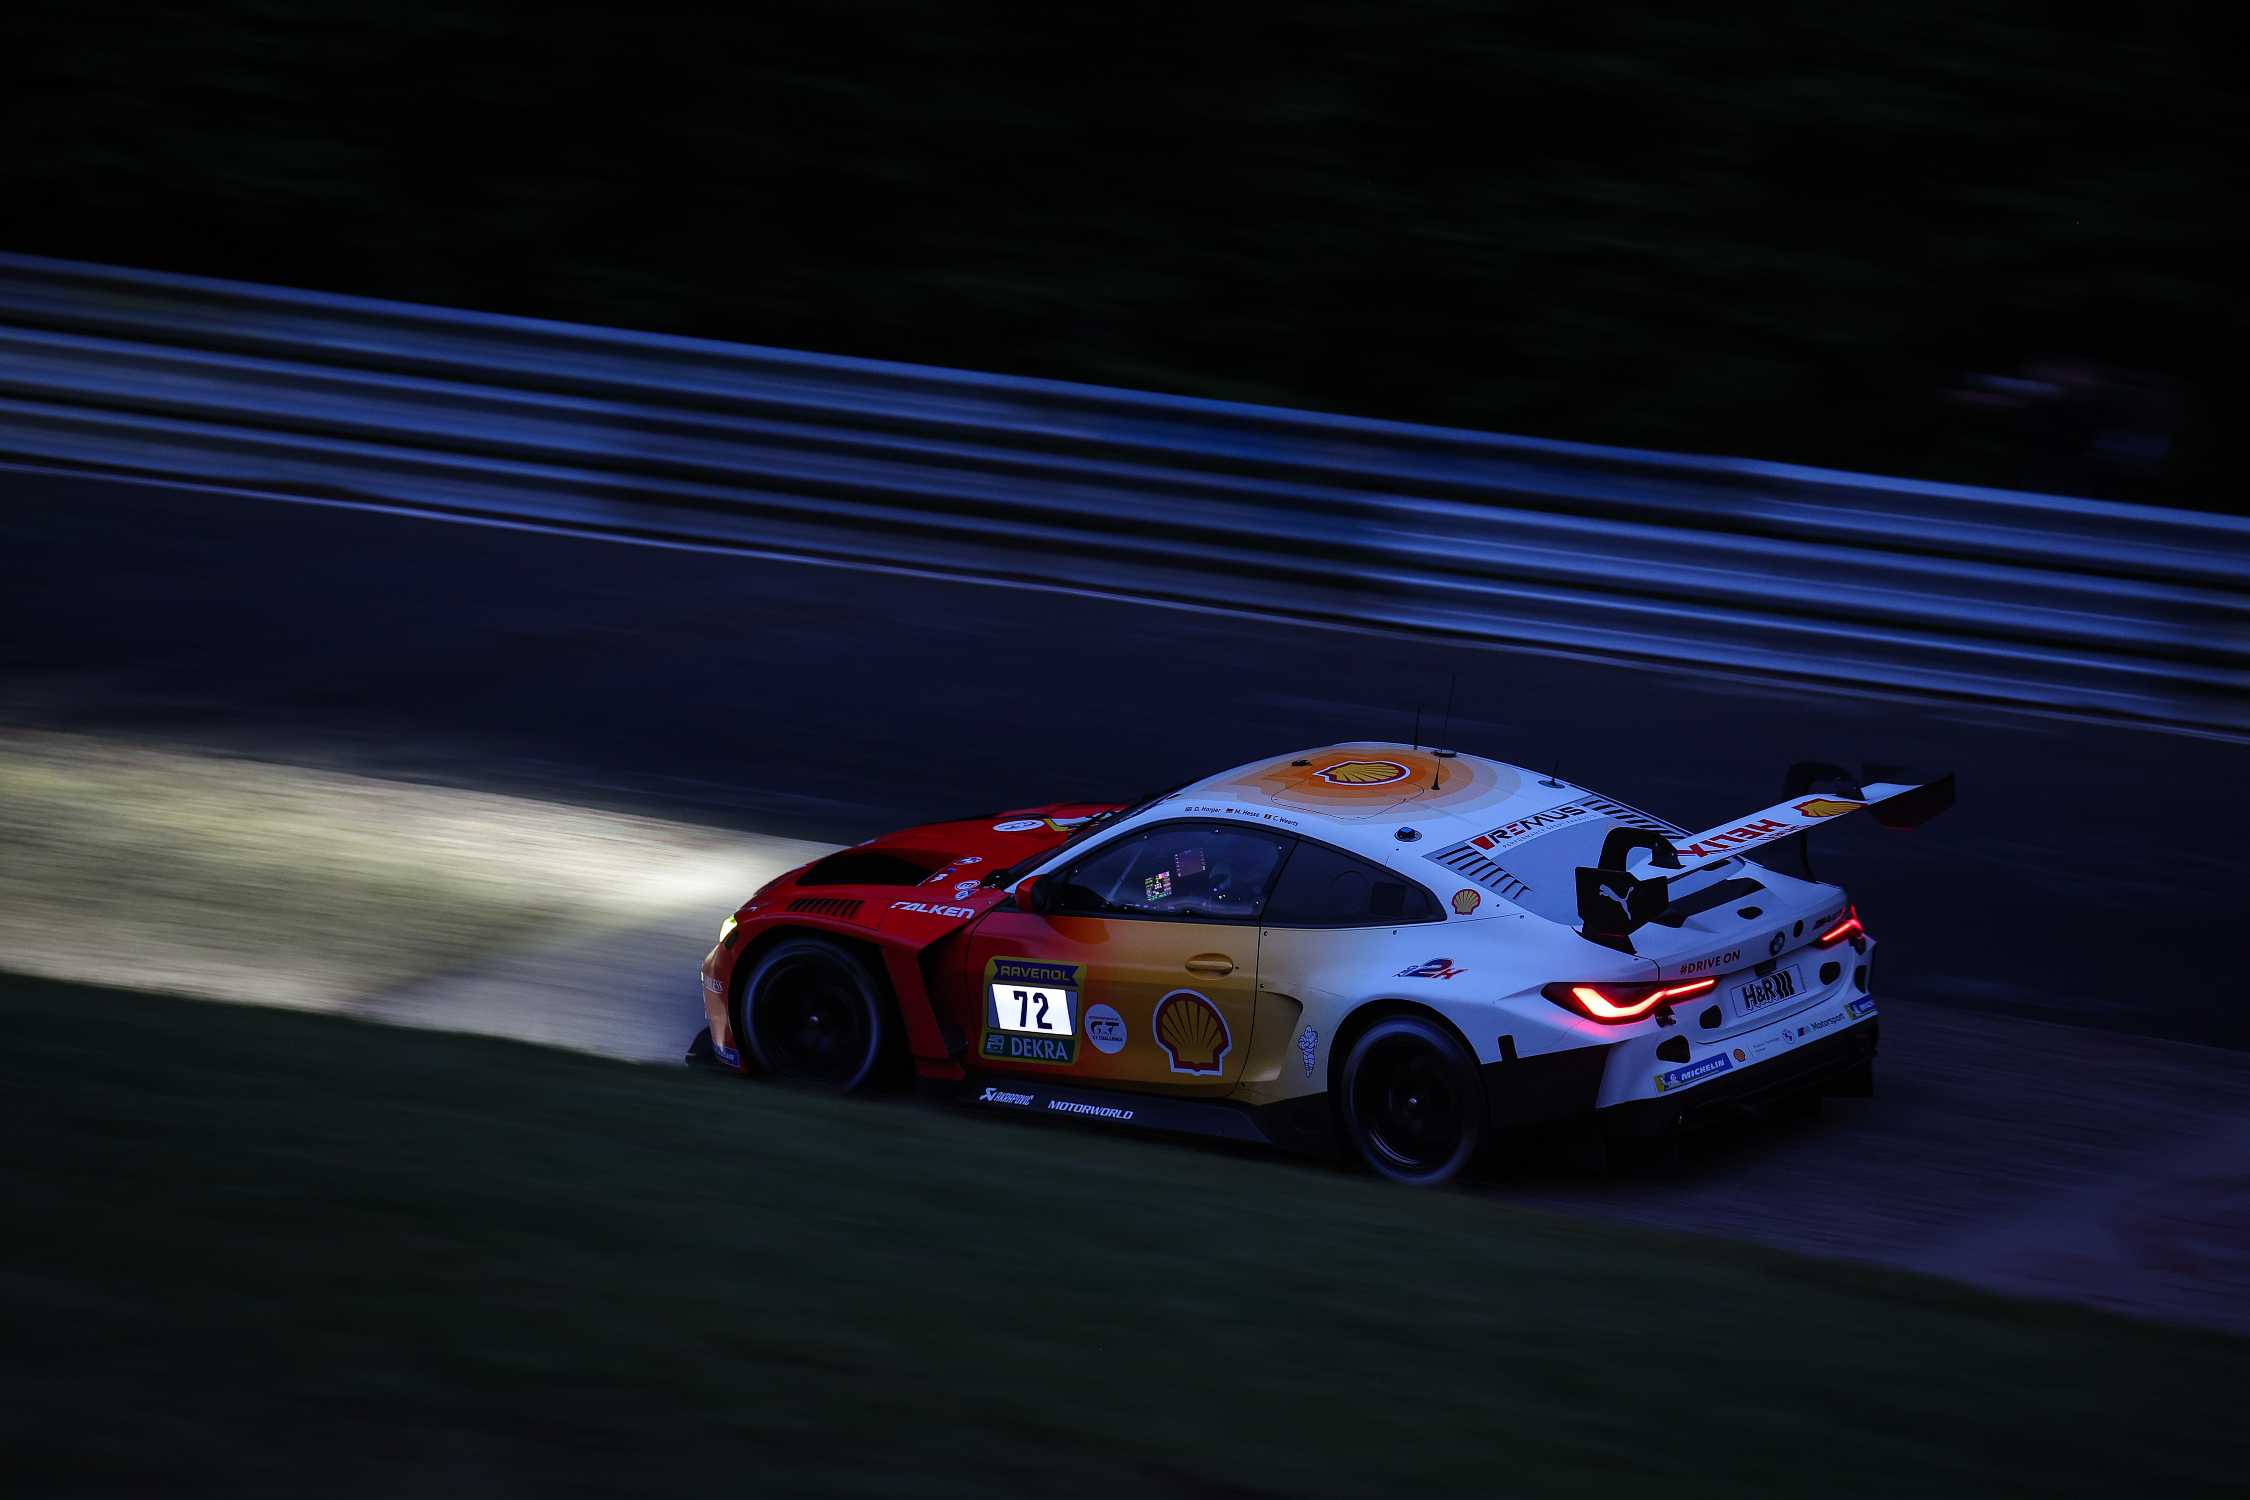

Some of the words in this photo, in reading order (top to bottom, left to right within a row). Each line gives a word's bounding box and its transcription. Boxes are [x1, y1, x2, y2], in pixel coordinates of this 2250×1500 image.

[1488, 806, 1587, 844] REMUS
[889, 901, 976, 920] FALKEN
[1000, 965, 1070, 981] RAVENOL
[1680, 954, 1721, 976] #DRIVE
[1722, 950, 1741, 965] ON
[1013, 990, 1053, 1030] 72
[1011, 1036, 1069, 1061] DEKRA
[1681, 1058, 1725, 1081] MICHELIN
[1047, 1099, 1135, 1120] MOTORWORLD
